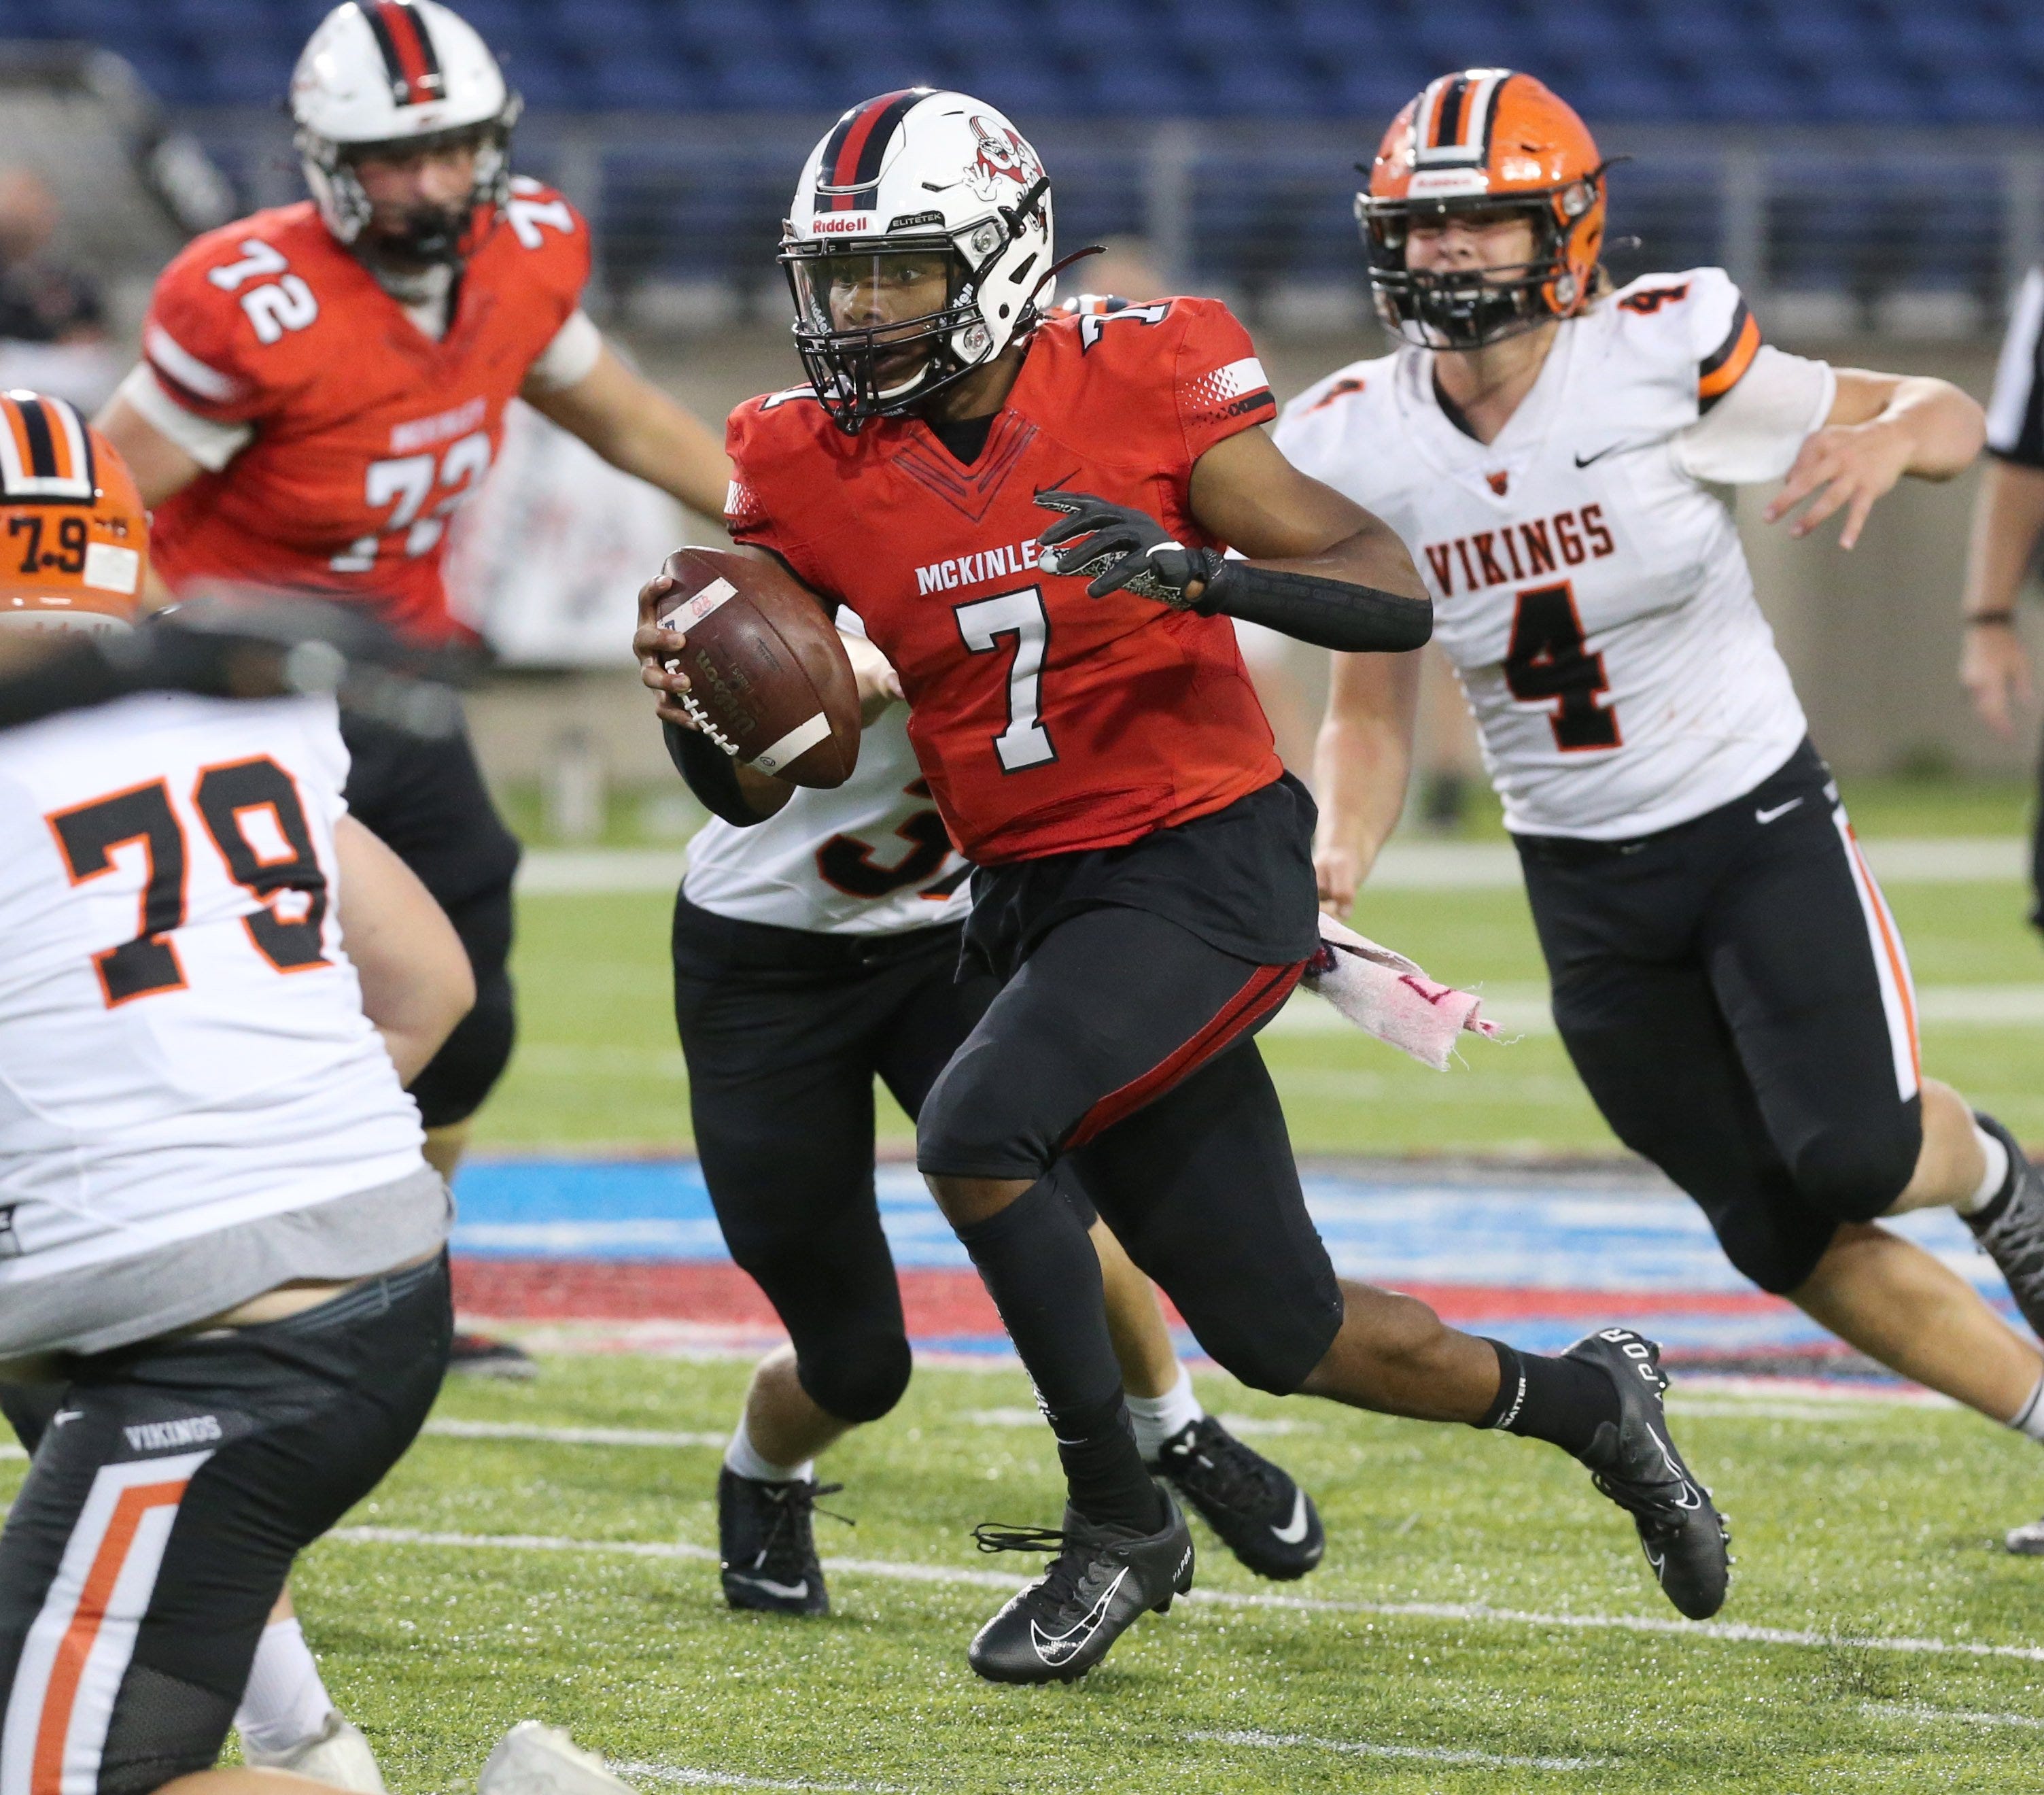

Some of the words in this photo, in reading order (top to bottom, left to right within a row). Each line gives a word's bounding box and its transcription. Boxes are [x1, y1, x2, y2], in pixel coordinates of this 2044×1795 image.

[812, 217, 867, 234] Riddell
[892, 213, 942, 227] ELITETEK
[207, 238, 319, 345] 72
[1616, 281, 1691, 315] 4
[1078, 301, 1173, 357] 7
[914, 538, 1039, 596] MCKINLE
[1424, 502, 1616, 598] VIKINGS
[951, 583, 1060, 776] 7
[1503, 579, 1623, 753] 4
[44, 753, 335, 1010] 79
[124, 1414, 223, 1452] VIKINGS
[1172, 1545, 1192, 1584] VAPOR
